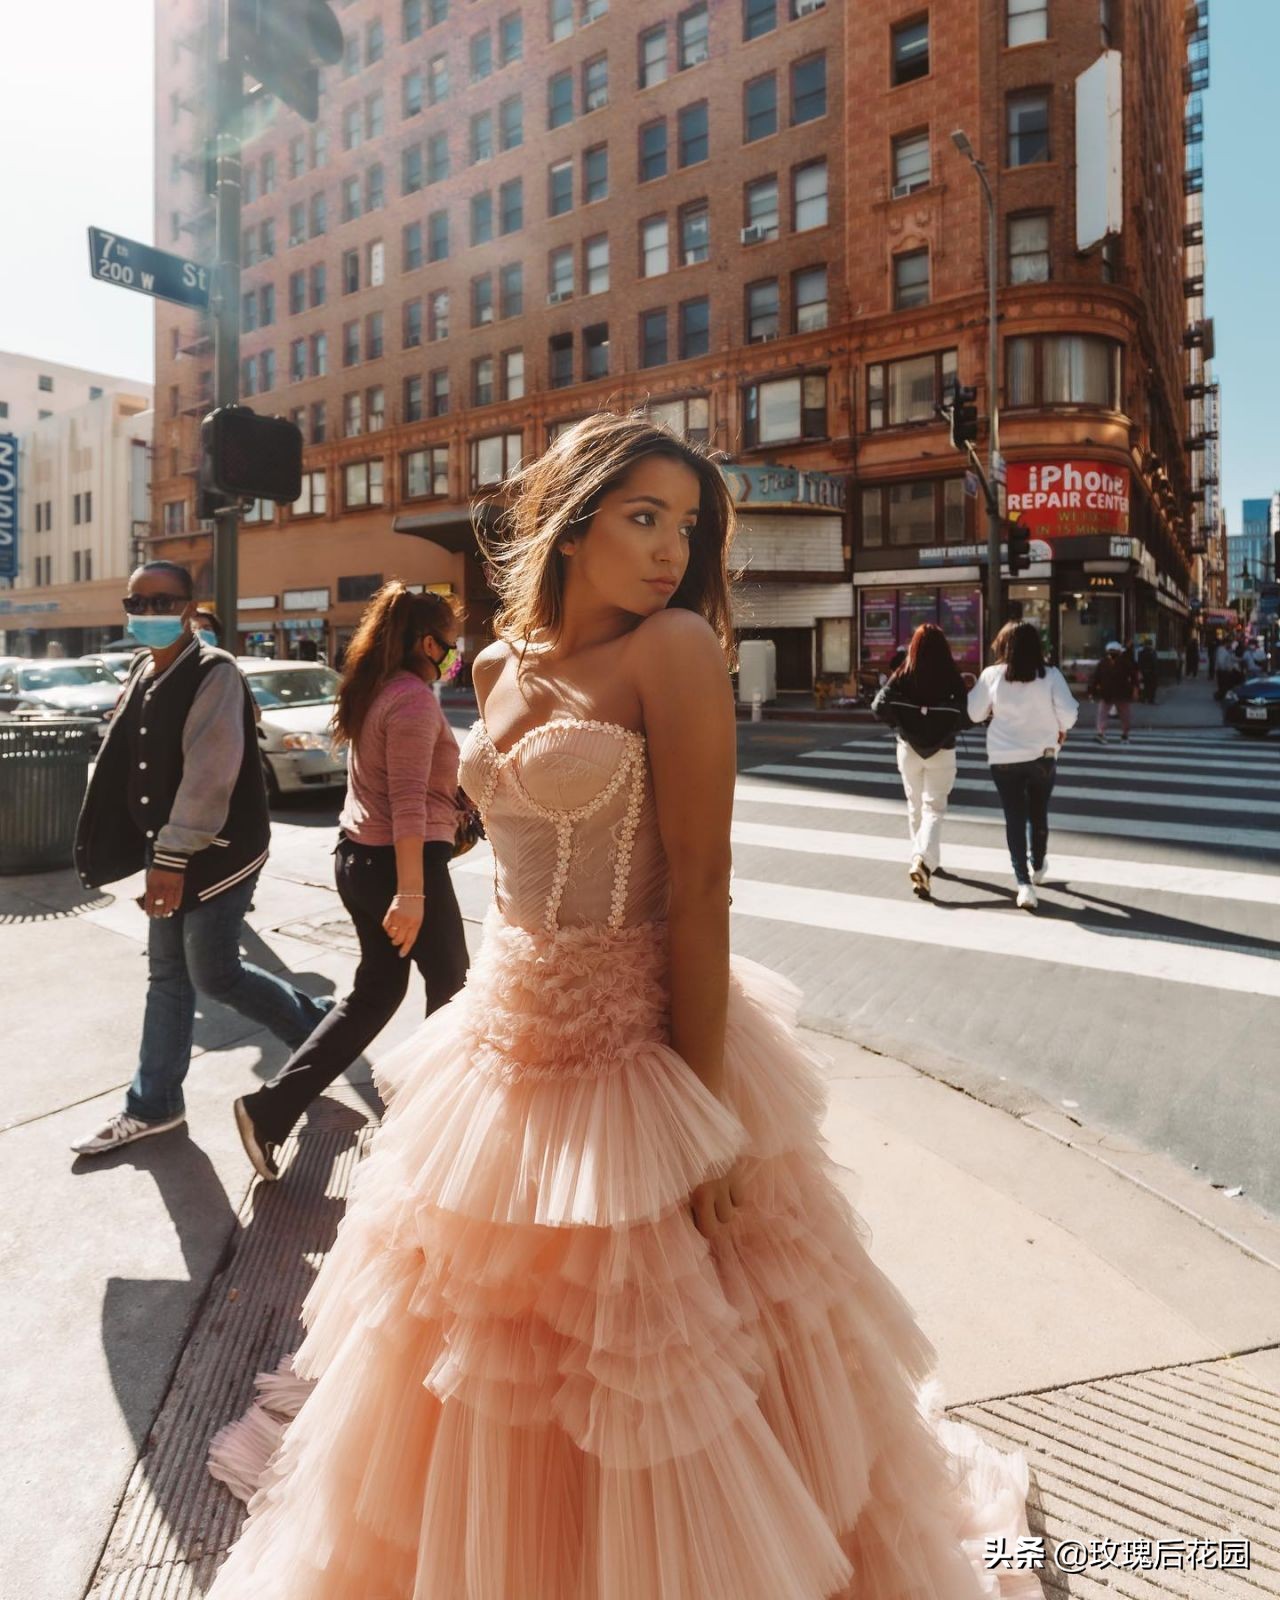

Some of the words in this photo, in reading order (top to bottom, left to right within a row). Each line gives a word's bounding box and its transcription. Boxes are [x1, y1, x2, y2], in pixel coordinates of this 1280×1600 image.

[98, 233, 128, 258] 7th
[182, 262, 206, 290] St
[98, 259, 134, 284] 200
[140, 271, 155, 290] W
[1029, 463, 1123, 495] iPhone
[1007, 492, 1081, 510] REPAIR
